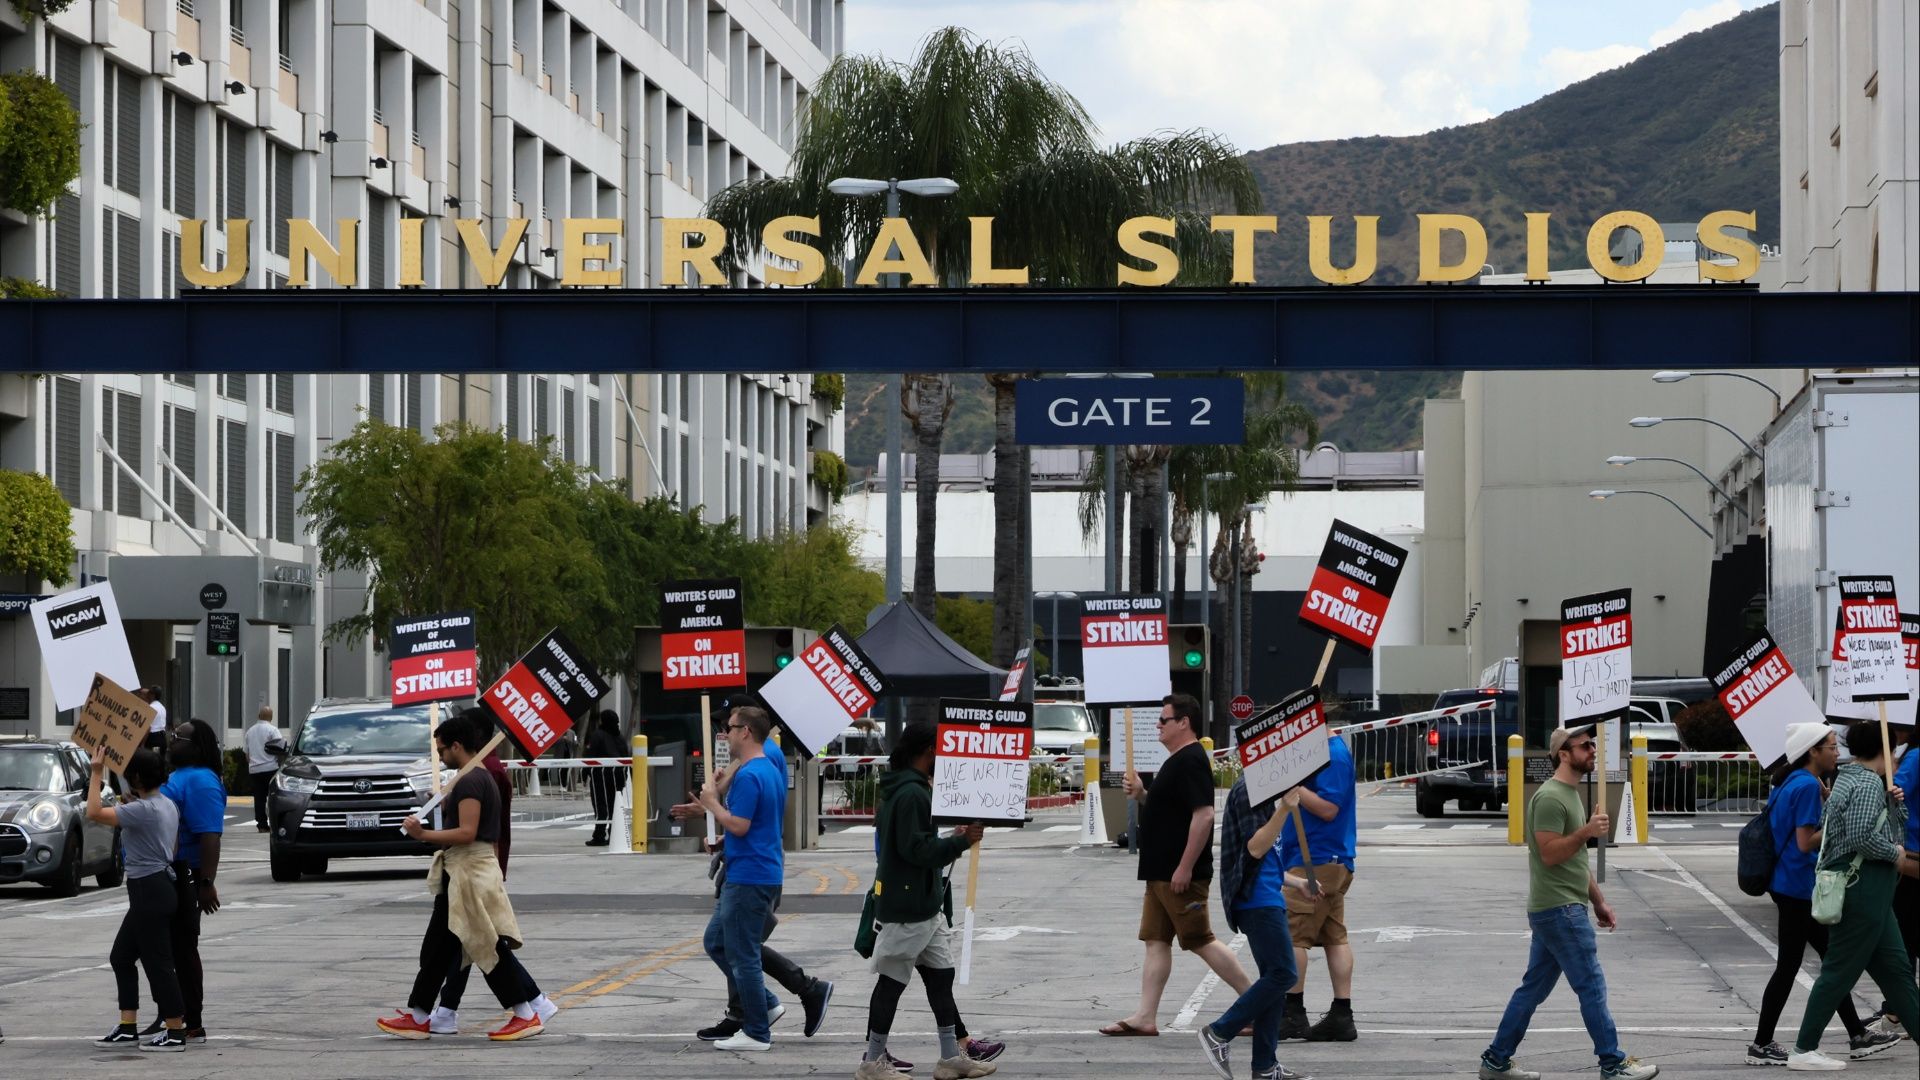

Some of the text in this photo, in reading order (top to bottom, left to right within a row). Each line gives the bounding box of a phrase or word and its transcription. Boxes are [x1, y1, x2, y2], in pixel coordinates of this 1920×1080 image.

[180, 210, 1760, 288] UNIVERSAL STUDIOS
[1048, 397, 1211, 427] GATE 2
[1333, 530, 1399, 568] WRITERS GUILD
[1356, 556, 1368, 566] OF
[1336, 560, 1377, 586] AMERICA
[664, 588, 736, 603] WRITERS GUILD
[1342, 586, 1360, 602] ON
[1841, 580, 1893, 593] WRITERS GUILD
[695, 604, 706, 613] OF
[1085, 597, 1162, 611] WRITERS GUILD
[1307, 589, 1378, 636] STRIKE!
[1565, 598, 1626, 620] WRITERS GUILD
[50, 605, 101, 630] WGAW
[395, 616, 471, 635] WRITERS GUILD
[680, 615, 723, 628] AMERICA
[1119, 612, 1130, 620] ON
[1593, 616, 1602, 625] ON
[1845, 604, 1898, 629] STRIKE!
[428, 631, 439, 639] OF
[1086, 620, 1163, 643] STRIKE!
[1566, 619, 1627, 654] STRIKE!
[411, 639, 456, 653] AMERICA
[694, 638, 712, 652] ON
[425, 658, 443, 670] ON
[546, 638, 598, 698] WRITERS GUILD
[666, 652, 740, 678] STRIKE!
[829, 631, 882, 692] WRITERS GUILD
[843, 664, 853, 674] ON
[1567, 653, 1620, 689] IATSE
[1713, 637, 1769, 687] WRITERS GUILD
[1743, 666, 1752, 676] ON
[395, 668, 472, 695] STRIKE!
[537, 667, 571, 705] AMERICA
[558, 671, 570, 682] OF
[806, 646, 868, 713] STRIKE!
[1726, 654, 1787, 714] STRIKE!
[88, 676, 147, 728] RUNNING ON
[531, 692, 549, 710] ON
[1232, 703, 1252, 711] STOP
[493, 681, 555, 747] STRIKE!
[945, 707, 1026, 722] WRITERS GUILD
[1241, 695, 1315, 739] WRITERS GUILD
[1275, 720, 1285, 729] ON
[980, 722, 991, 731] ON
[1245, 709, 1319, 762] STRIKE!
[942, 730, 1025, 756] STRIKE!
[943, 760, 1024, 782] WE WRITE
[937, 781, 959, 792] THE
[940, 792, 970, 808] SHOW
[976, 790, 1006, 808] YOU
